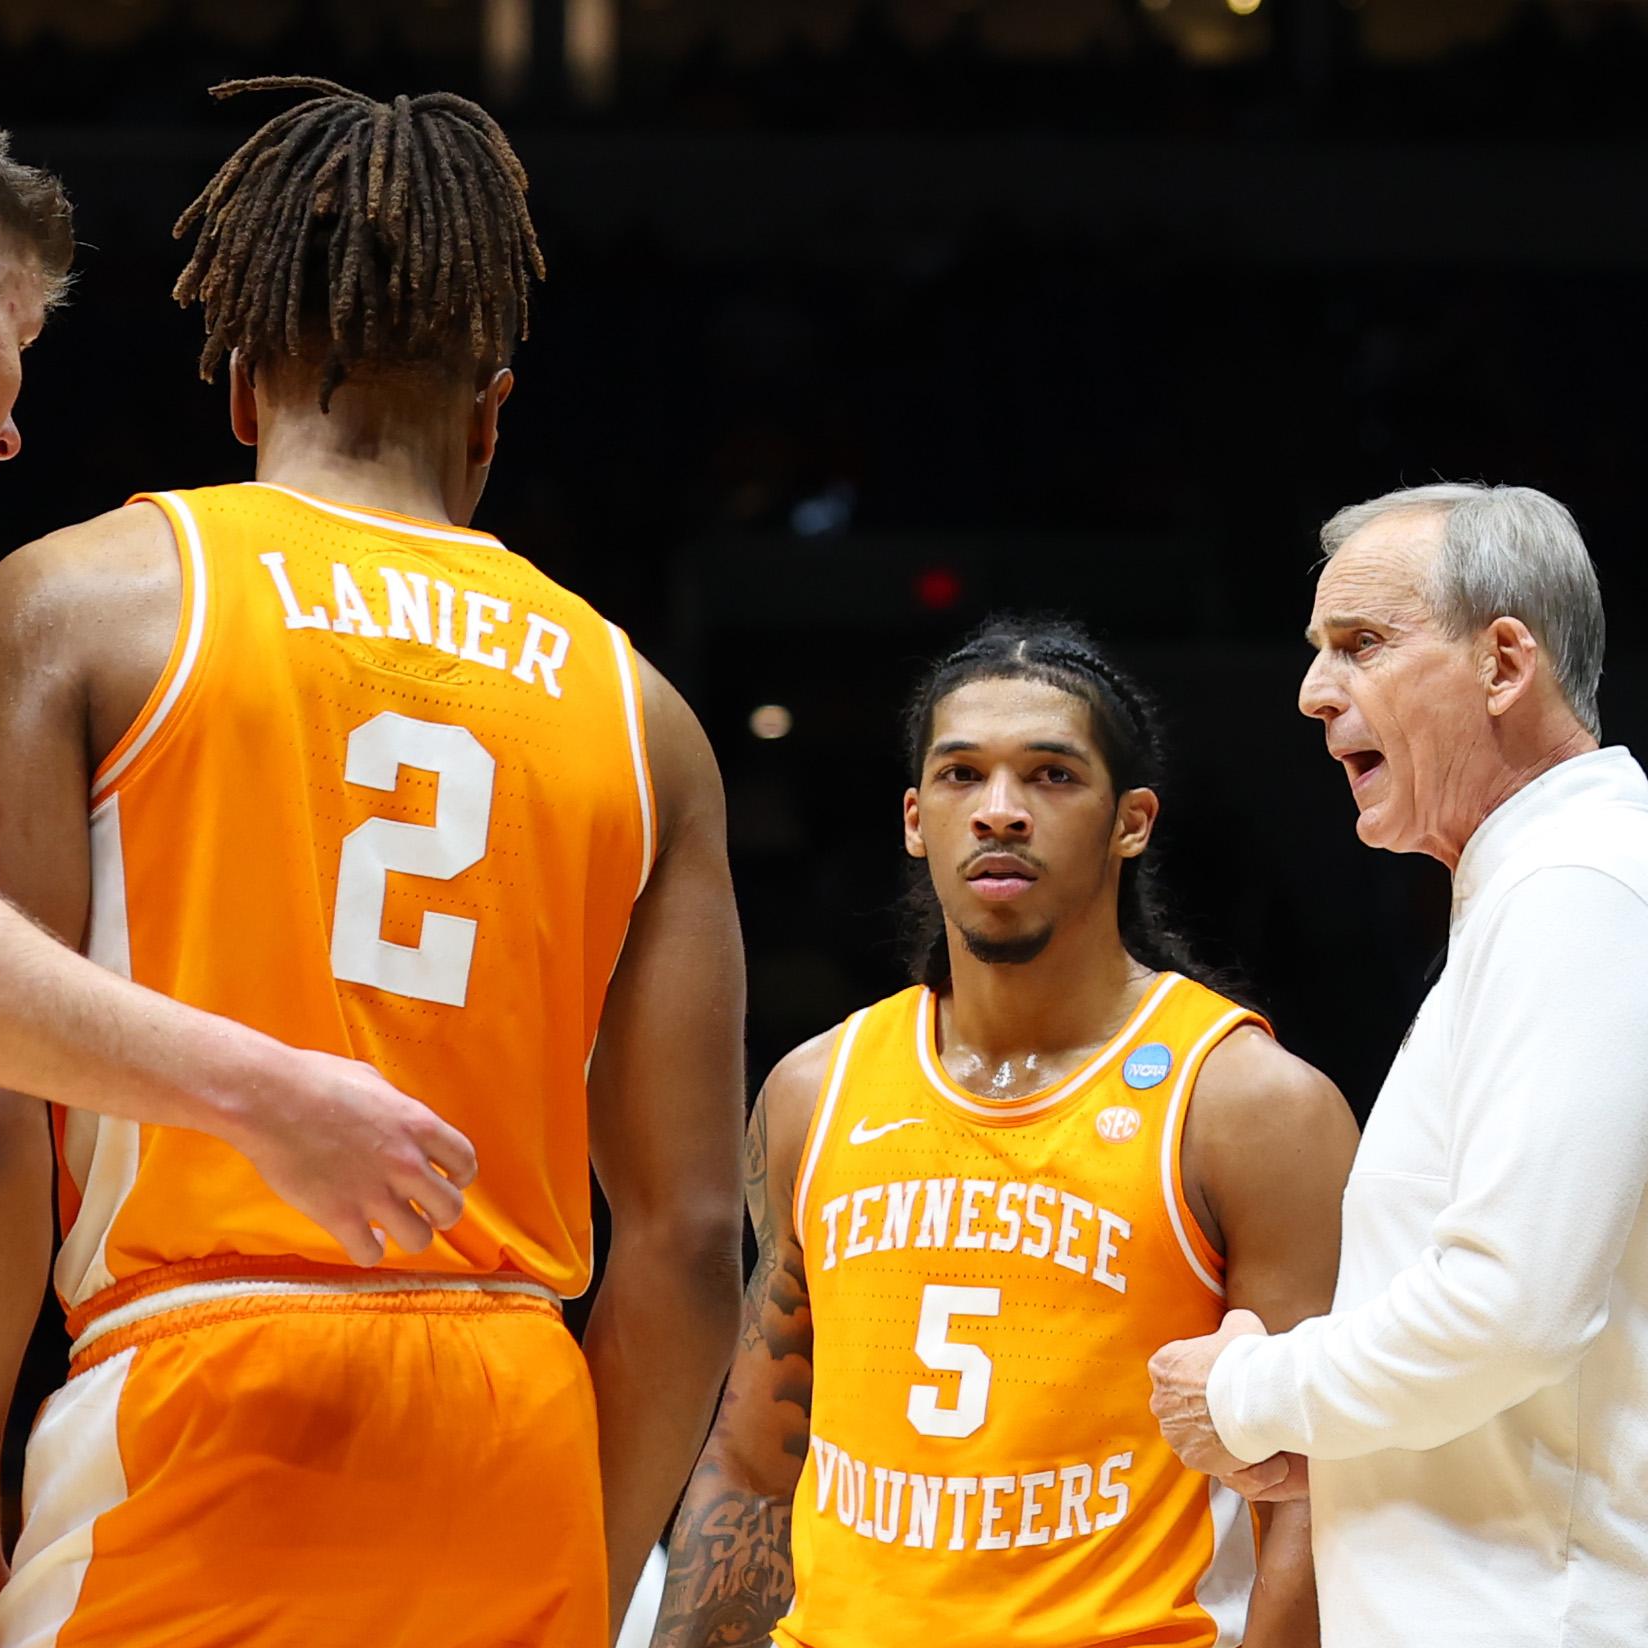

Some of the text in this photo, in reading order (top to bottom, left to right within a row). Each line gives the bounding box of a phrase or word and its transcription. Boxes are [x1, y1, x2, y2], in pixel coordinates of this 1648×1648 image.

[259, 552, 570, 698] LANIER
[330, 711, 496, 1008] 2
[1097, 1106, 1138, 1139] SEC
[1129, 1063, 1168, 1078] NCAA
[821, 1178, 1132, 1294] TENNESSEE
[906, 1284, 1001, 1438] 5
[811, 1435, 1133, 1551] VOLUNTEERS
